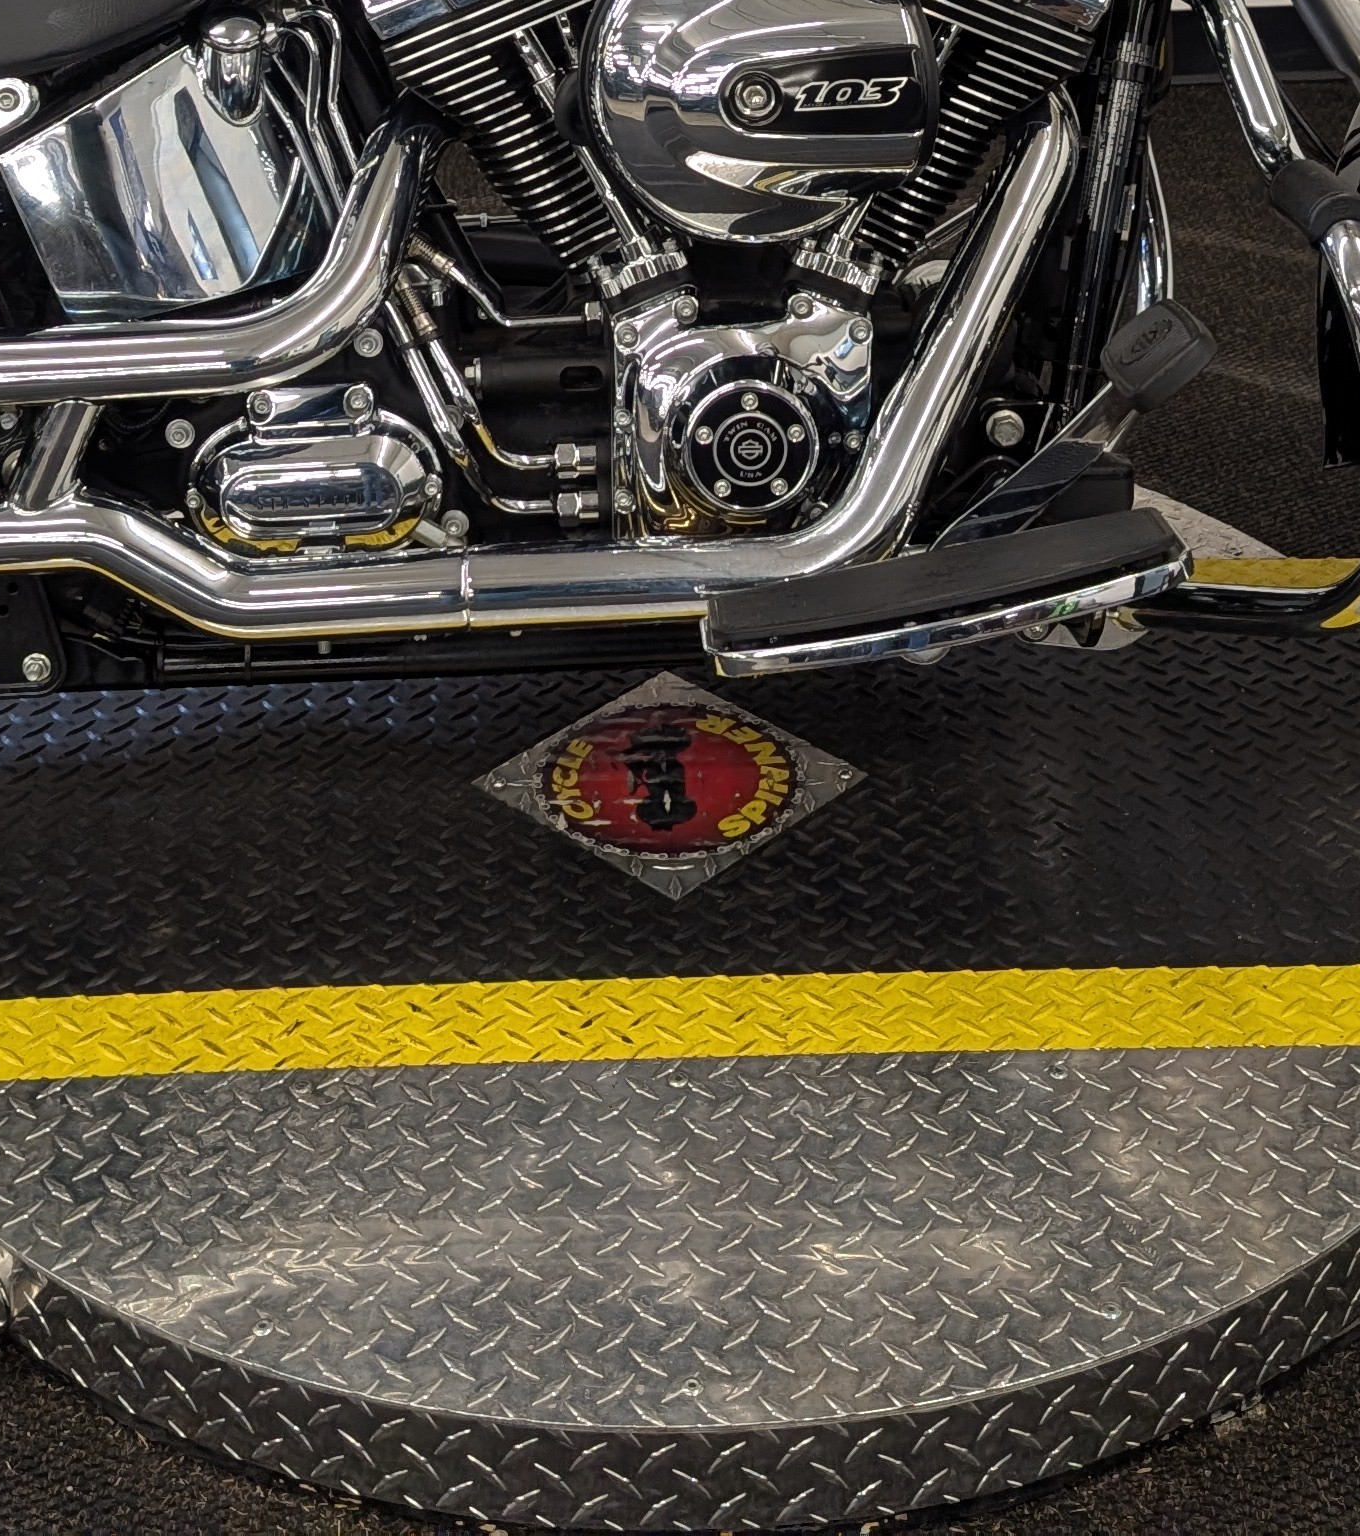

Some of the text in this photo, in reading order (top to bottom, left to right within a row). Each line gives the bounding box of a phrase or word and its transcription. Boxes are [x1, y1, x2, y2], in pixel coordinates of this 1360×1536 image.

[794, 77, 908, 111] 103
[552, 737, 594, 821] CYCLE
[695, 712, 790, 839] SPINNER
